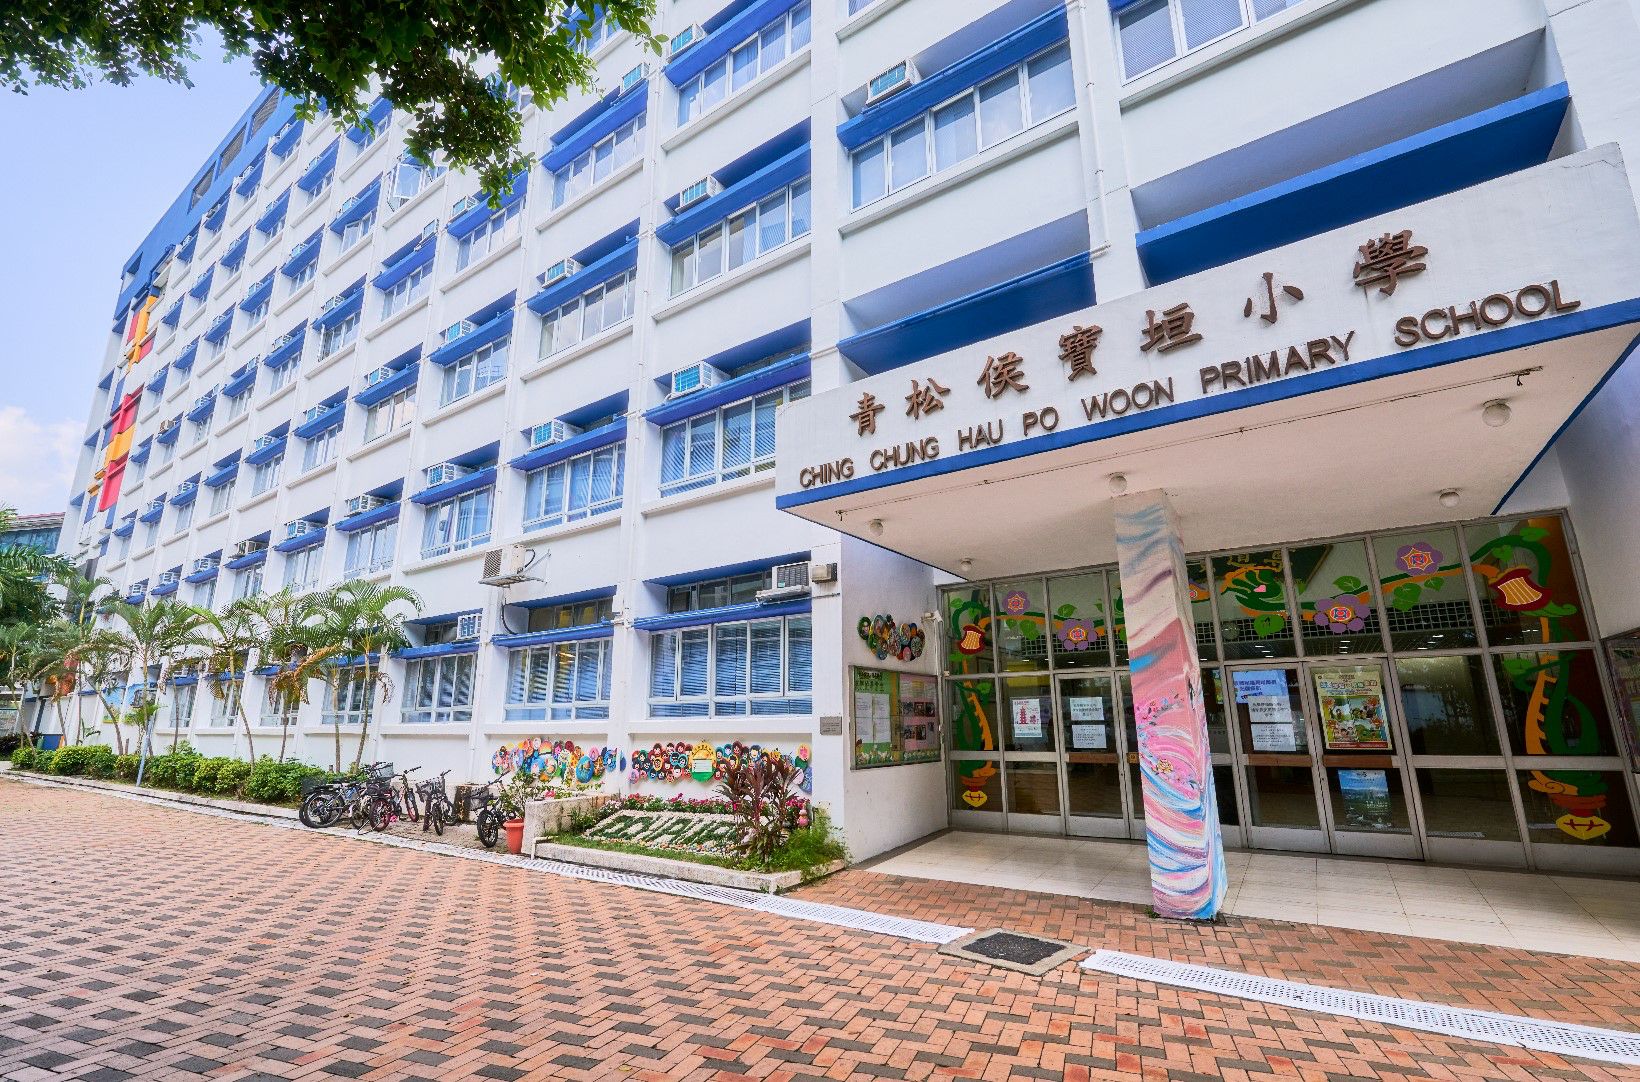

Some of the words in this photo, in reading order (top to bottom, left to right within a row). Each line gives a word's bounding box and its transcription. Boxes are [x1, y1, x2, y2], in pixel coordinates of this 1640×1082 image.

[799, 457, 854, 488] CHING
[869, 436, 939, 471] CHUNG
[958, 418, 1004, 451] HAU
[1023, 406, 1059, 436] PO
[1081, 377, 1175, 422] WOON
[1199, 330, 1356, 394] PRIMARY
[1394, 279, 1581, 347] SCHOOL
[849, 229, 1428, 436] 青松侯寶垣小學
